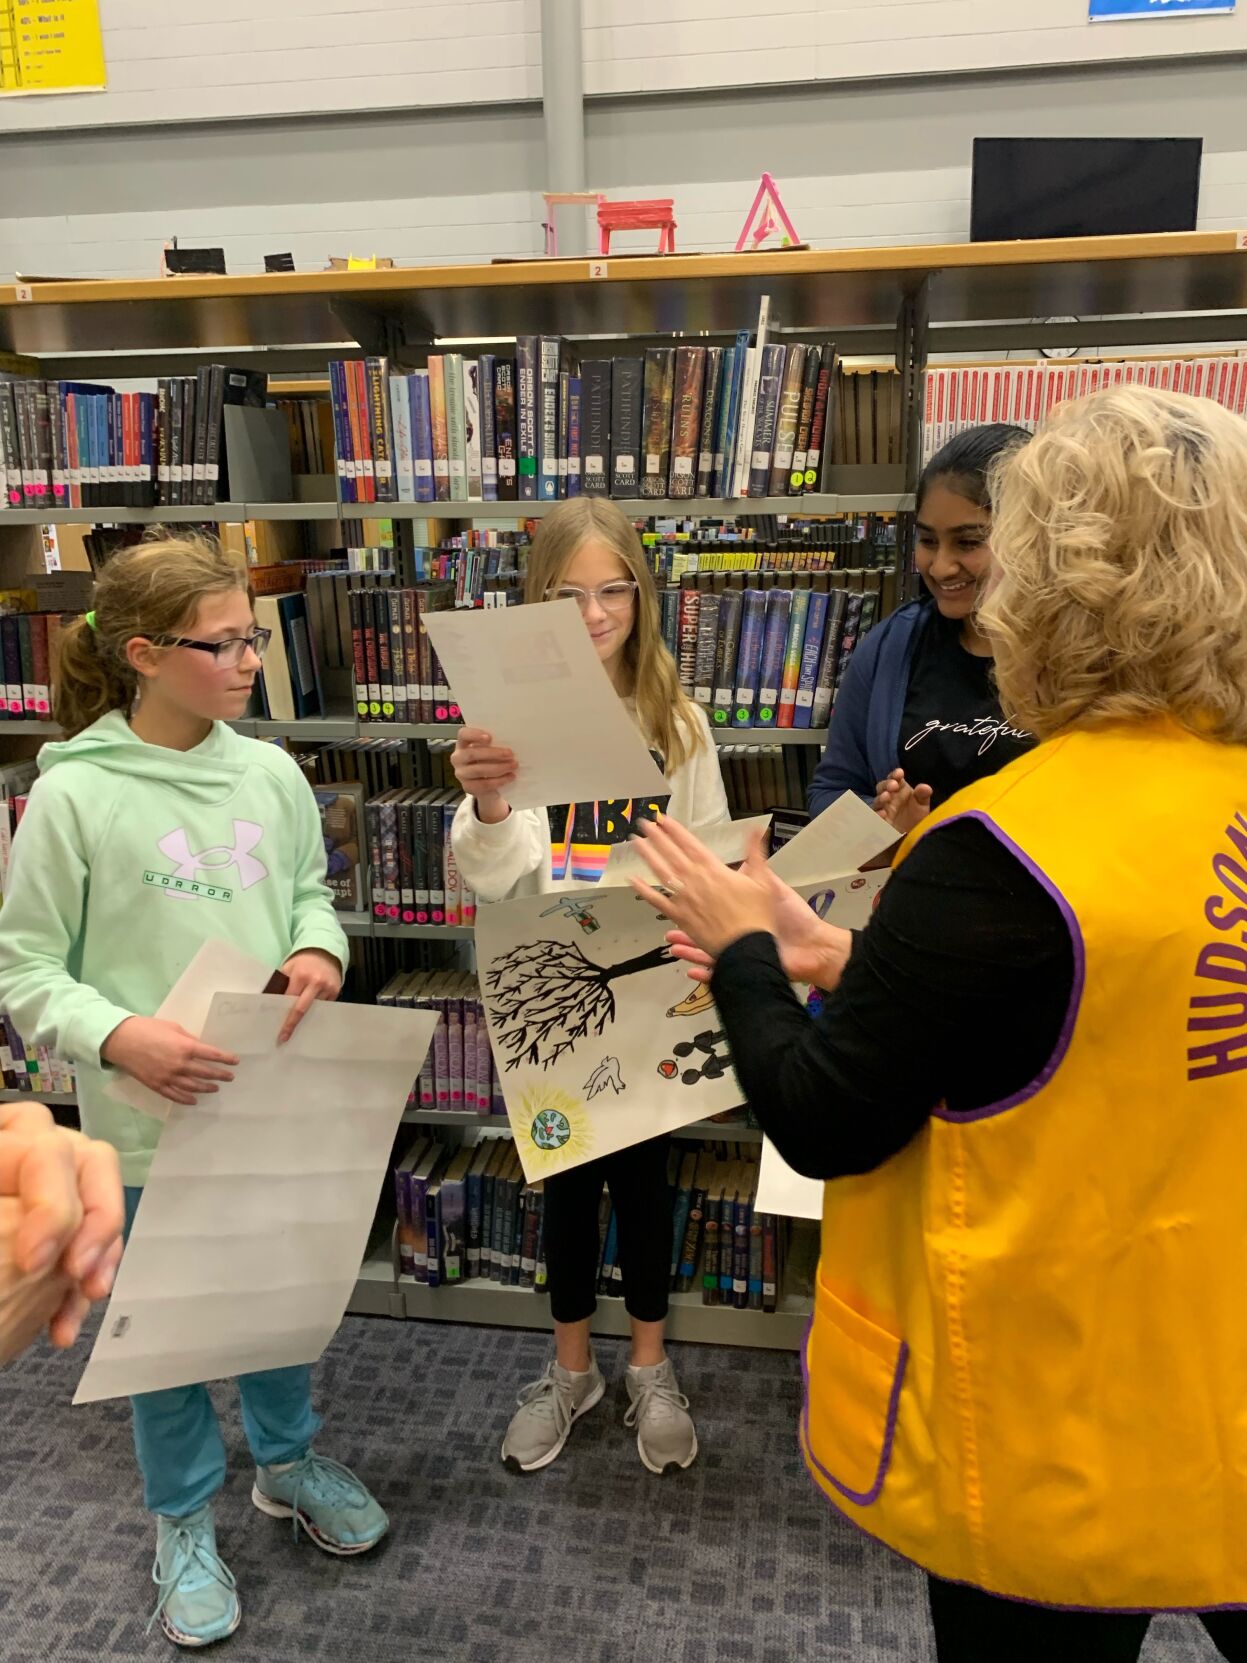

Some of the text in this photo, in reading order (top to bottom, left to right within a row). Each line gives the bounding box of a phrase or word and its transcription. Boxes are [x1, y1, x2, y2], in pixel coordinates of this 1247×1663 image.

[594, 266, 601, 276] 2
[20, 288, 27, 299] 2
[372, 376, 383, 435] LIGHTNING
[520, 408, 527, 419] IN
[544, 388, 556, 430] ENDER'S
[679, 394, 693, 438] RUINS
[762, 400, 776, 444] SUMMER
[777, 390, 801, 453] PULSE
[681, 596, 698, 643] SUPER
[679, 652, 695, 684] HUM
[803, 643, 819, 664] EACH
[340, 878, 351, 887] of
